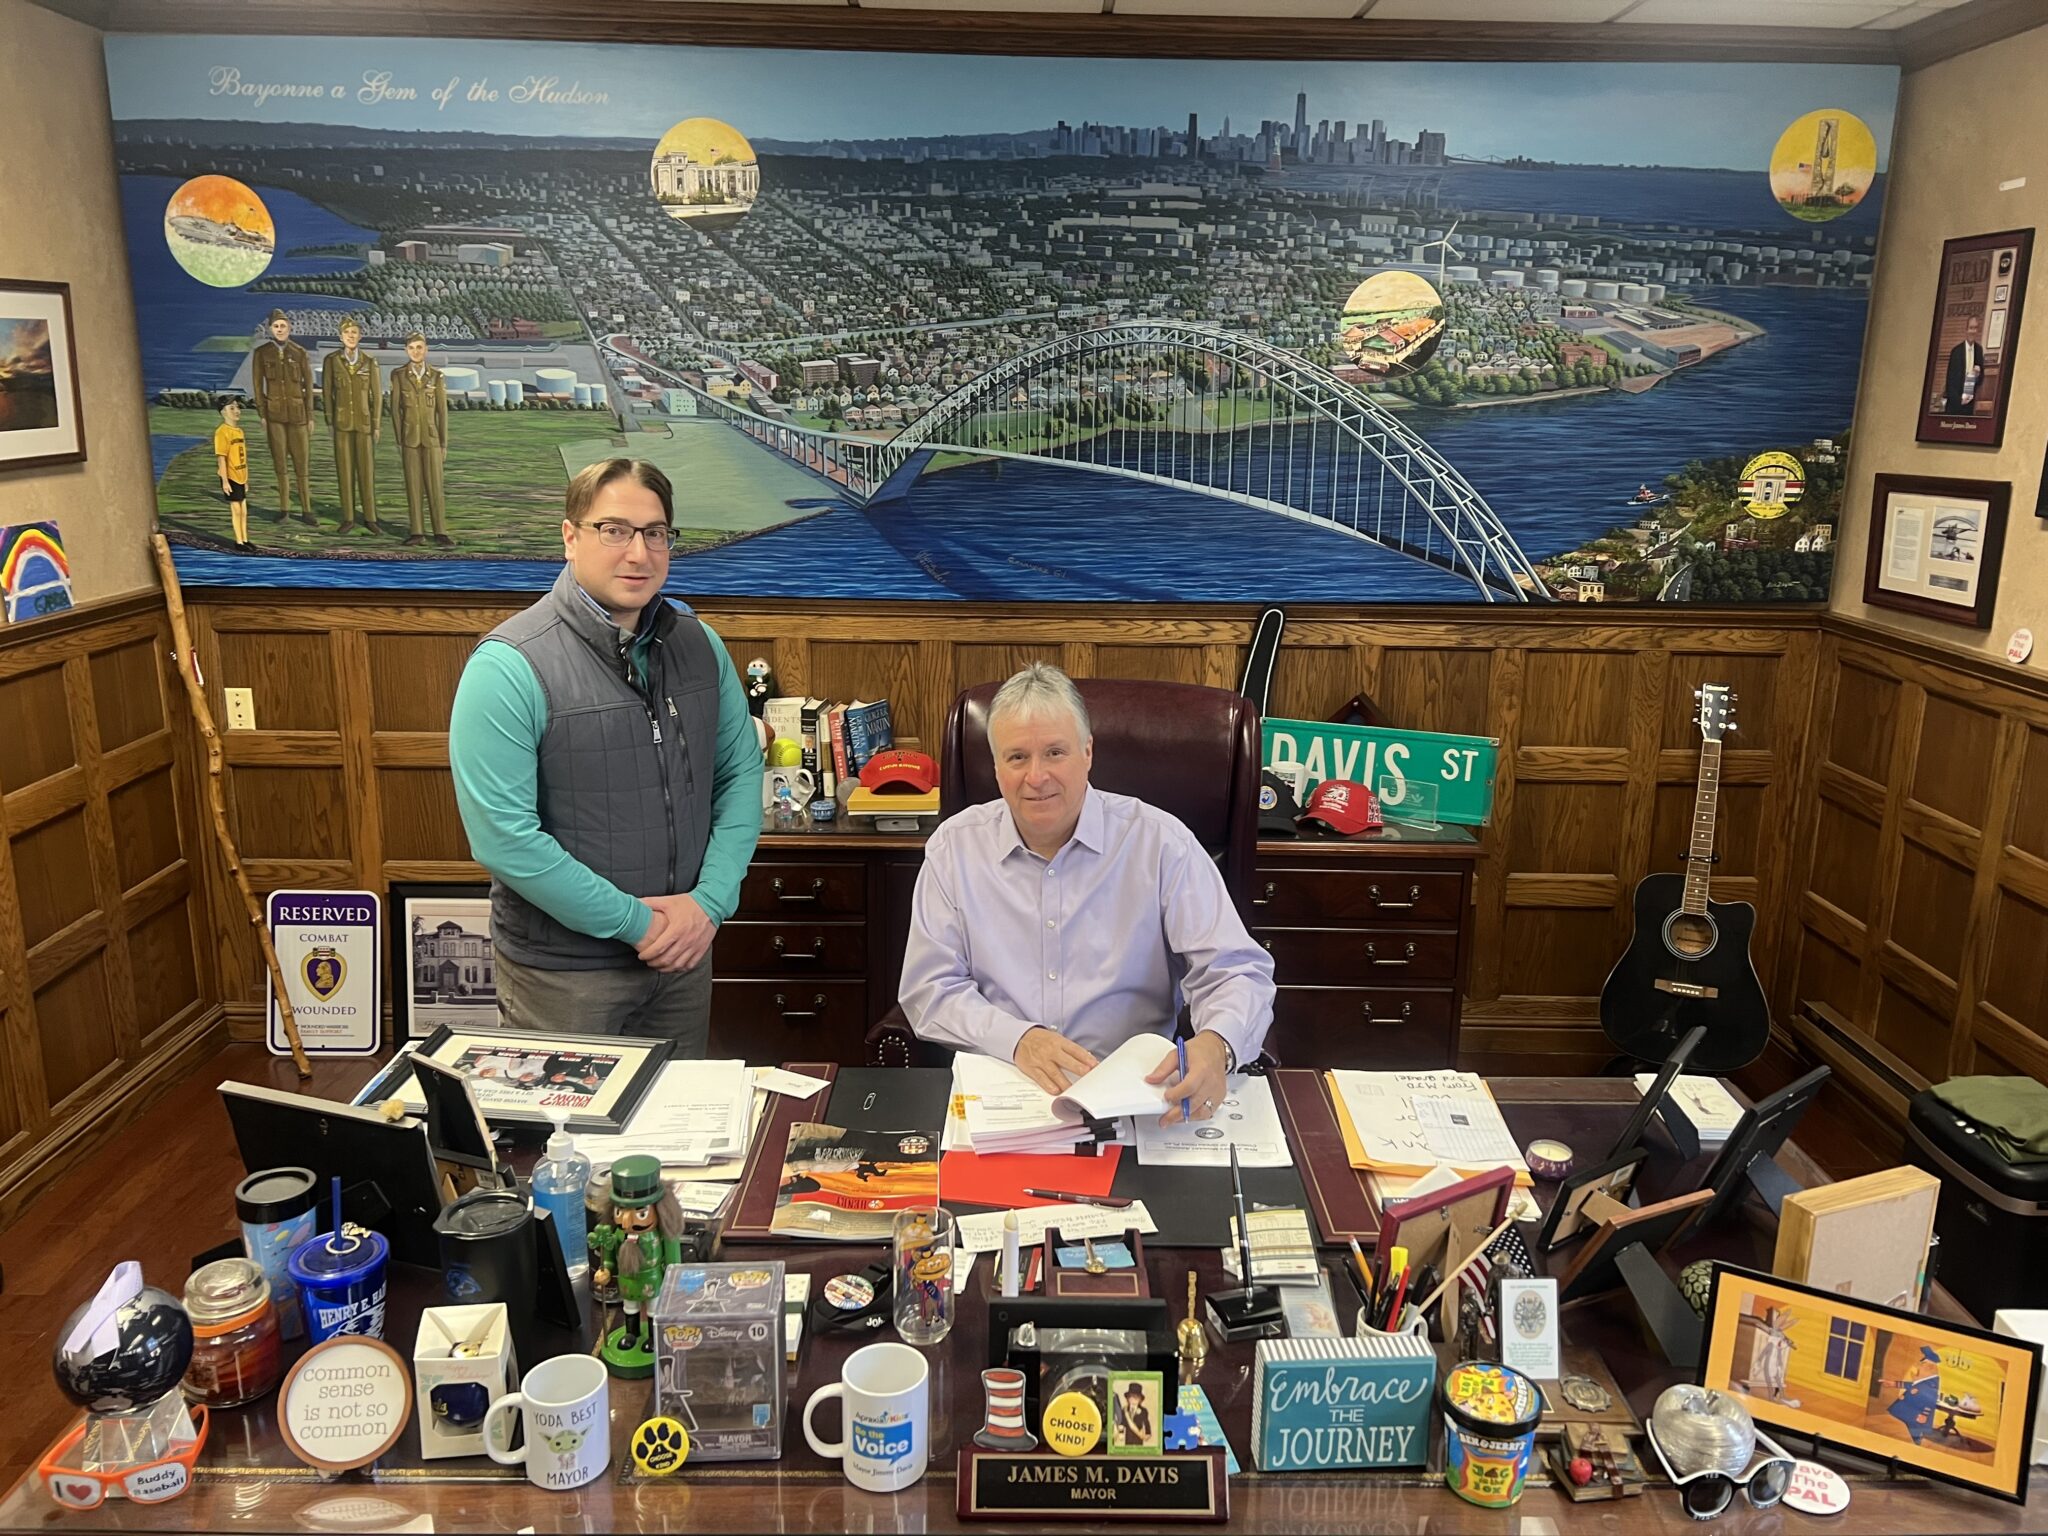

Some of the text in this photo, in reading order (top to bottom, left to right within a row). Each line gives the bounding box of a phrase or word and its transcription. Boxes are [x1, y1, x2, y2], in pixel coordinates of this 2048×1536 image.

[208, 65, 610, 111] Bayonne a Gem of the Hudson
[2008, 649, 2023, 659] PAL
[1271, 732, 1479, 806] DAVIS ST
[279, 906, 371, 922] RESERVED
[299, 933, 350, 943] COMBAT
[292, 1005, 357, 1016] WOUNDED
[318, 1302, 359, 1329] HENRY
[665, 1325, 765, 1341] POP! Disney 10
[302, 1362, 391, 1382] common
[318, 1380, 376, 1399] sense
[1270, 1366, 1428, 1413] Embrace
[304, 1400, 389, 1421] is not so
[532, 1401, 599, 1428] YODA BEST
[1070, 1406, 1077, 1416] I
[1330, 1408, 1364, 1423] THE
[299, 1420, 390, 1441] common
[855, 1426, 884, 1439] Be the
[1049, 1418, 1096, 1433] CHOOSE
[718, 1434, 752, 1443] MAYOR
[855, 1434, 909, 1456] Voice
[1054, 1433, 1086, 1447] KIND!
[1272, 1425, 1416, 1467] JOURNEY
[1459, 1433, 1480, 1446] BEN
[137, 1469, 177, 1486] Buddy
[546, 1467, 590, 1486] MAYOR
[1007, 1465, 1180, 1485] JAMES M. DAVIS
[1798, 1465, 1835, 1480] ave
[54, 1481, 64, 1498] I
[133, 1476, 185, 1497] Baseball
[1792, 1473, 1828, 1490] The
[1070, 1488, 1117, 1500] MAYOR
[1787, 1486, 1838, 1508] PAL
